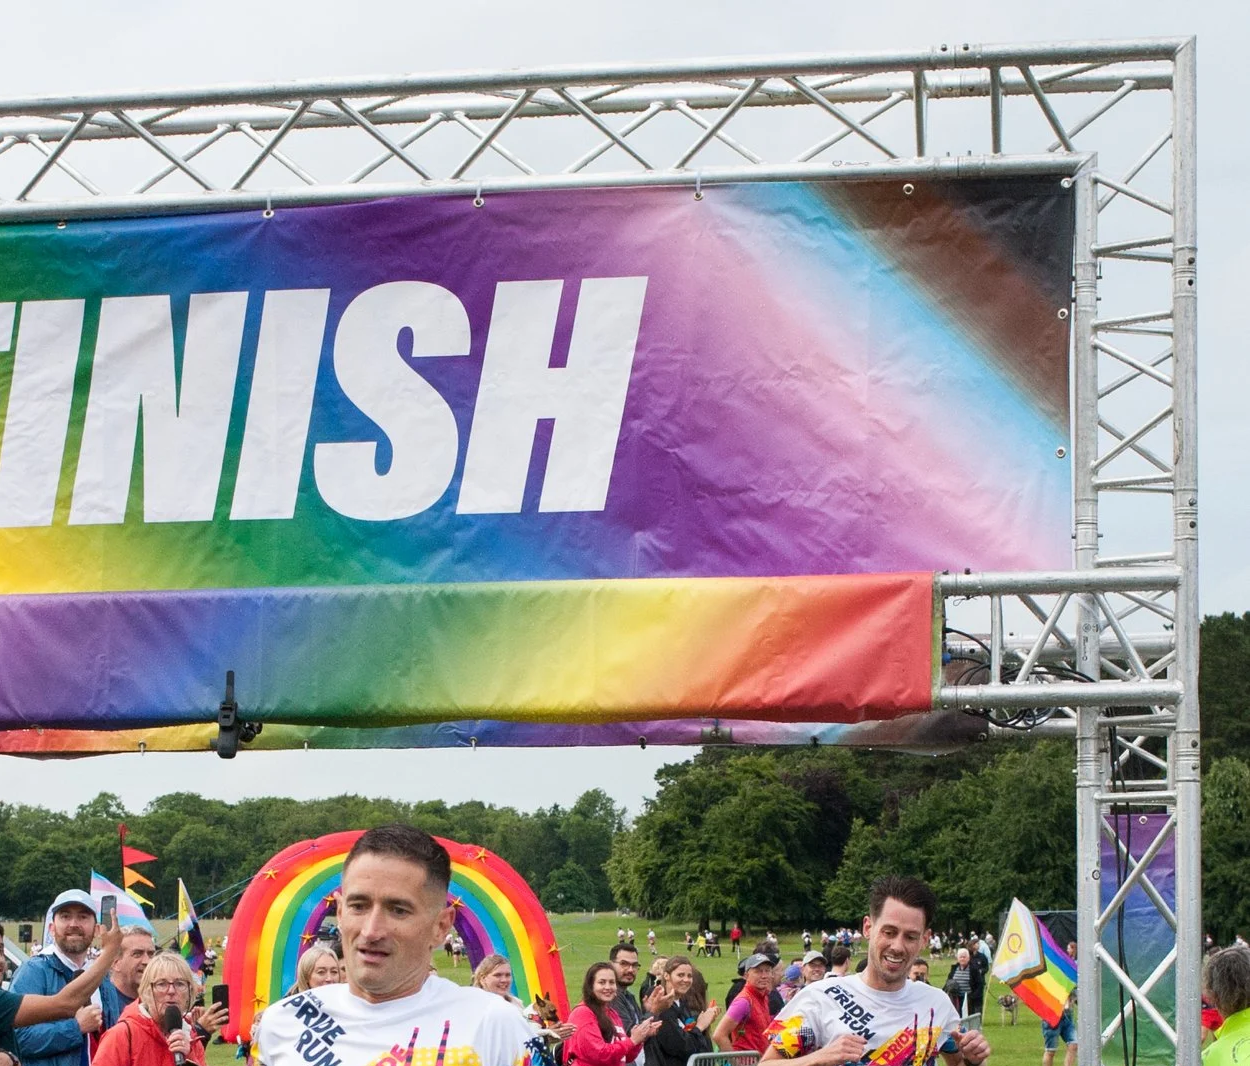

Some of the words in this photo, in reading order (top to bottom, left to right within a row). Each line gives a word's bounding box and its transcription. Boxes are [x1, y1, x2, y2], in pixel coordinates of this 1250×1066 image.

[282, 995, 346, 1047] PRIDE
[824, 986, 875, 1026] PRIDE
[839, 1011, 876, 1041] RUN
[882, 1026, 916, 1062] PRIDE
